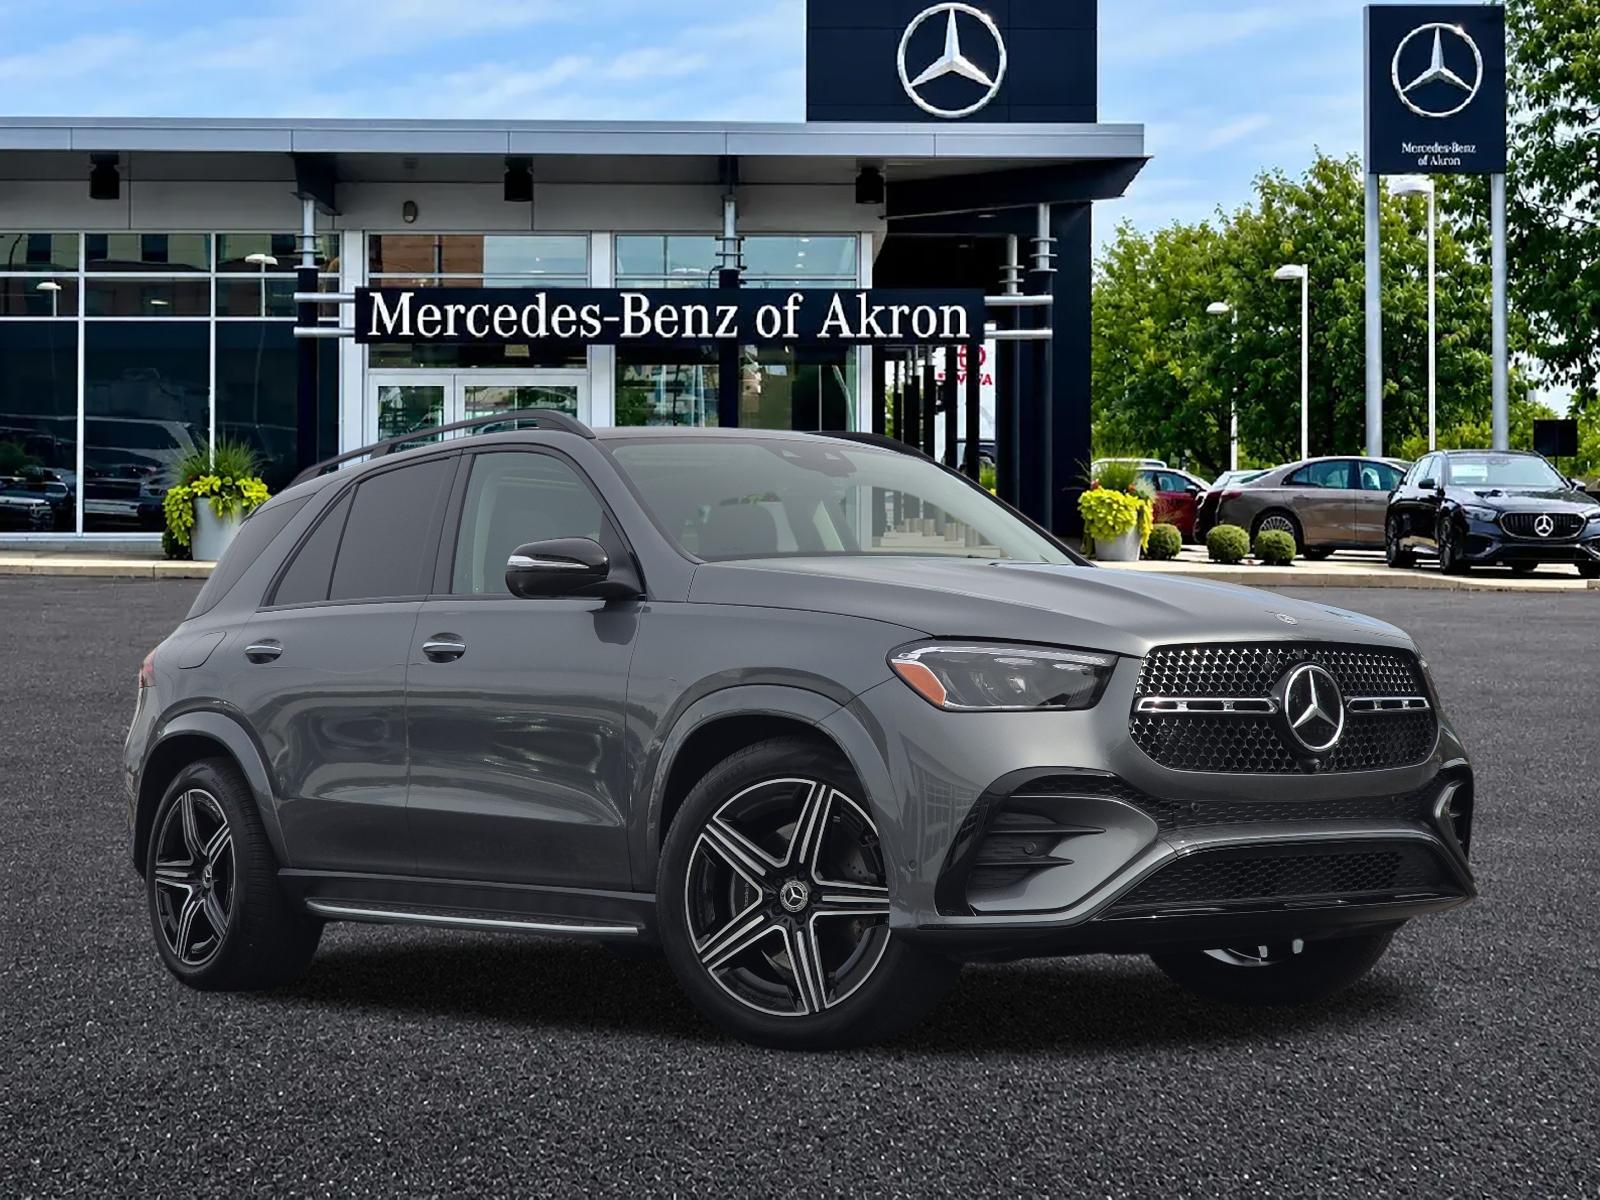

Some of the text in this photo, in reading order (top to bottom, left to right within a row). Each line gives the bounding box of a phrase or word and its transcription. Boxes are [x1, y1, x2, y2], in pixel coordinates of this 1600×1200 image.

[1401, 142, 1476, 153] Mercedes-Benz
[1417, 155, 1460, 166] of Akron
[367, 291, 970, 338] Mercedes-Benz of Akron
